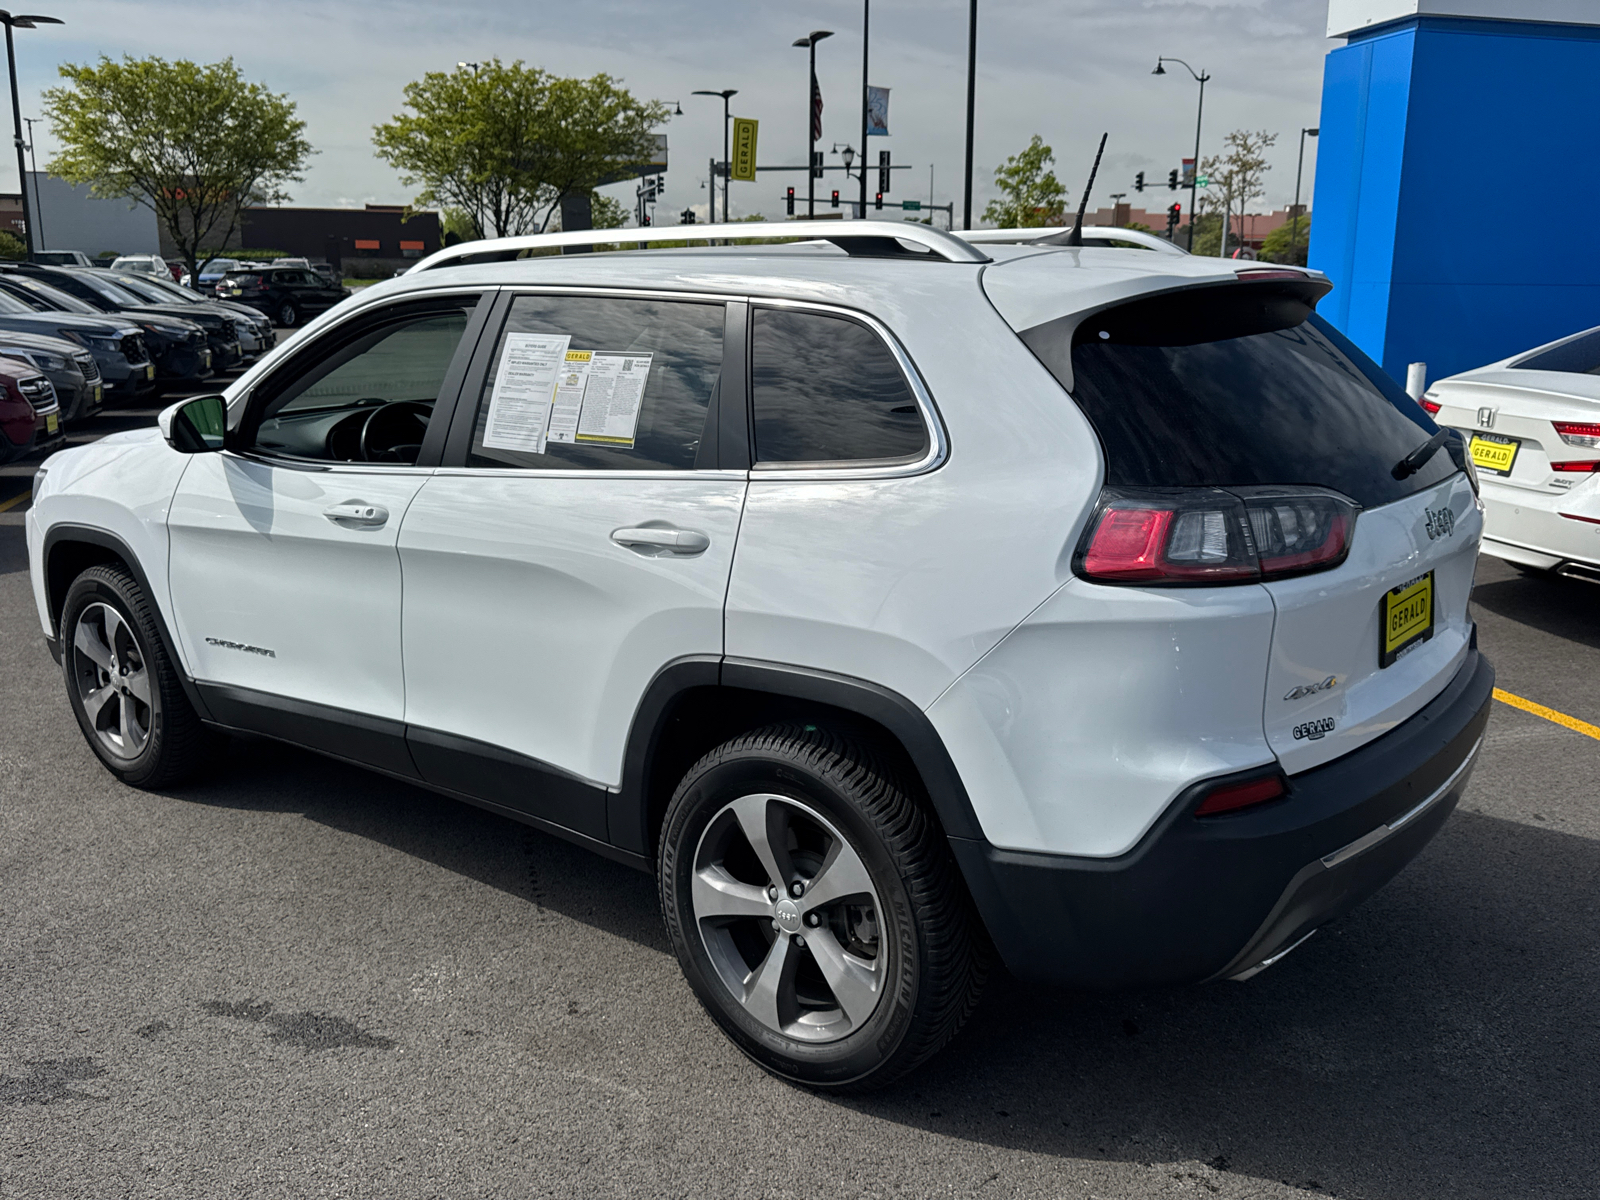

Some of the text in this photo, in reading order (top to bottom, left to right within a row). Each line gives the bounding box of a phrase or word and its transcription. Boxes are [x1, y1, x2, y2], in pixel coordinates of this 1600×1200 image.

[740, 126, 750, 173] GERALD
[567, 352, 590, 360] GERALD
[1474, 447, 1507, 461] GERALD
[1425, 506, 1454, 540] Jeep
[1392, 598, 1425, 631] GERALD
[205, 637, 276, 658] CHEROKEE
[1283, 675, 1336, 701] 4x4
[1293, 717, 1335, 740] GERALD
[663, 844, 681, 938] MICHELIN
[896, 901, 913, 1008] MICHELIN
